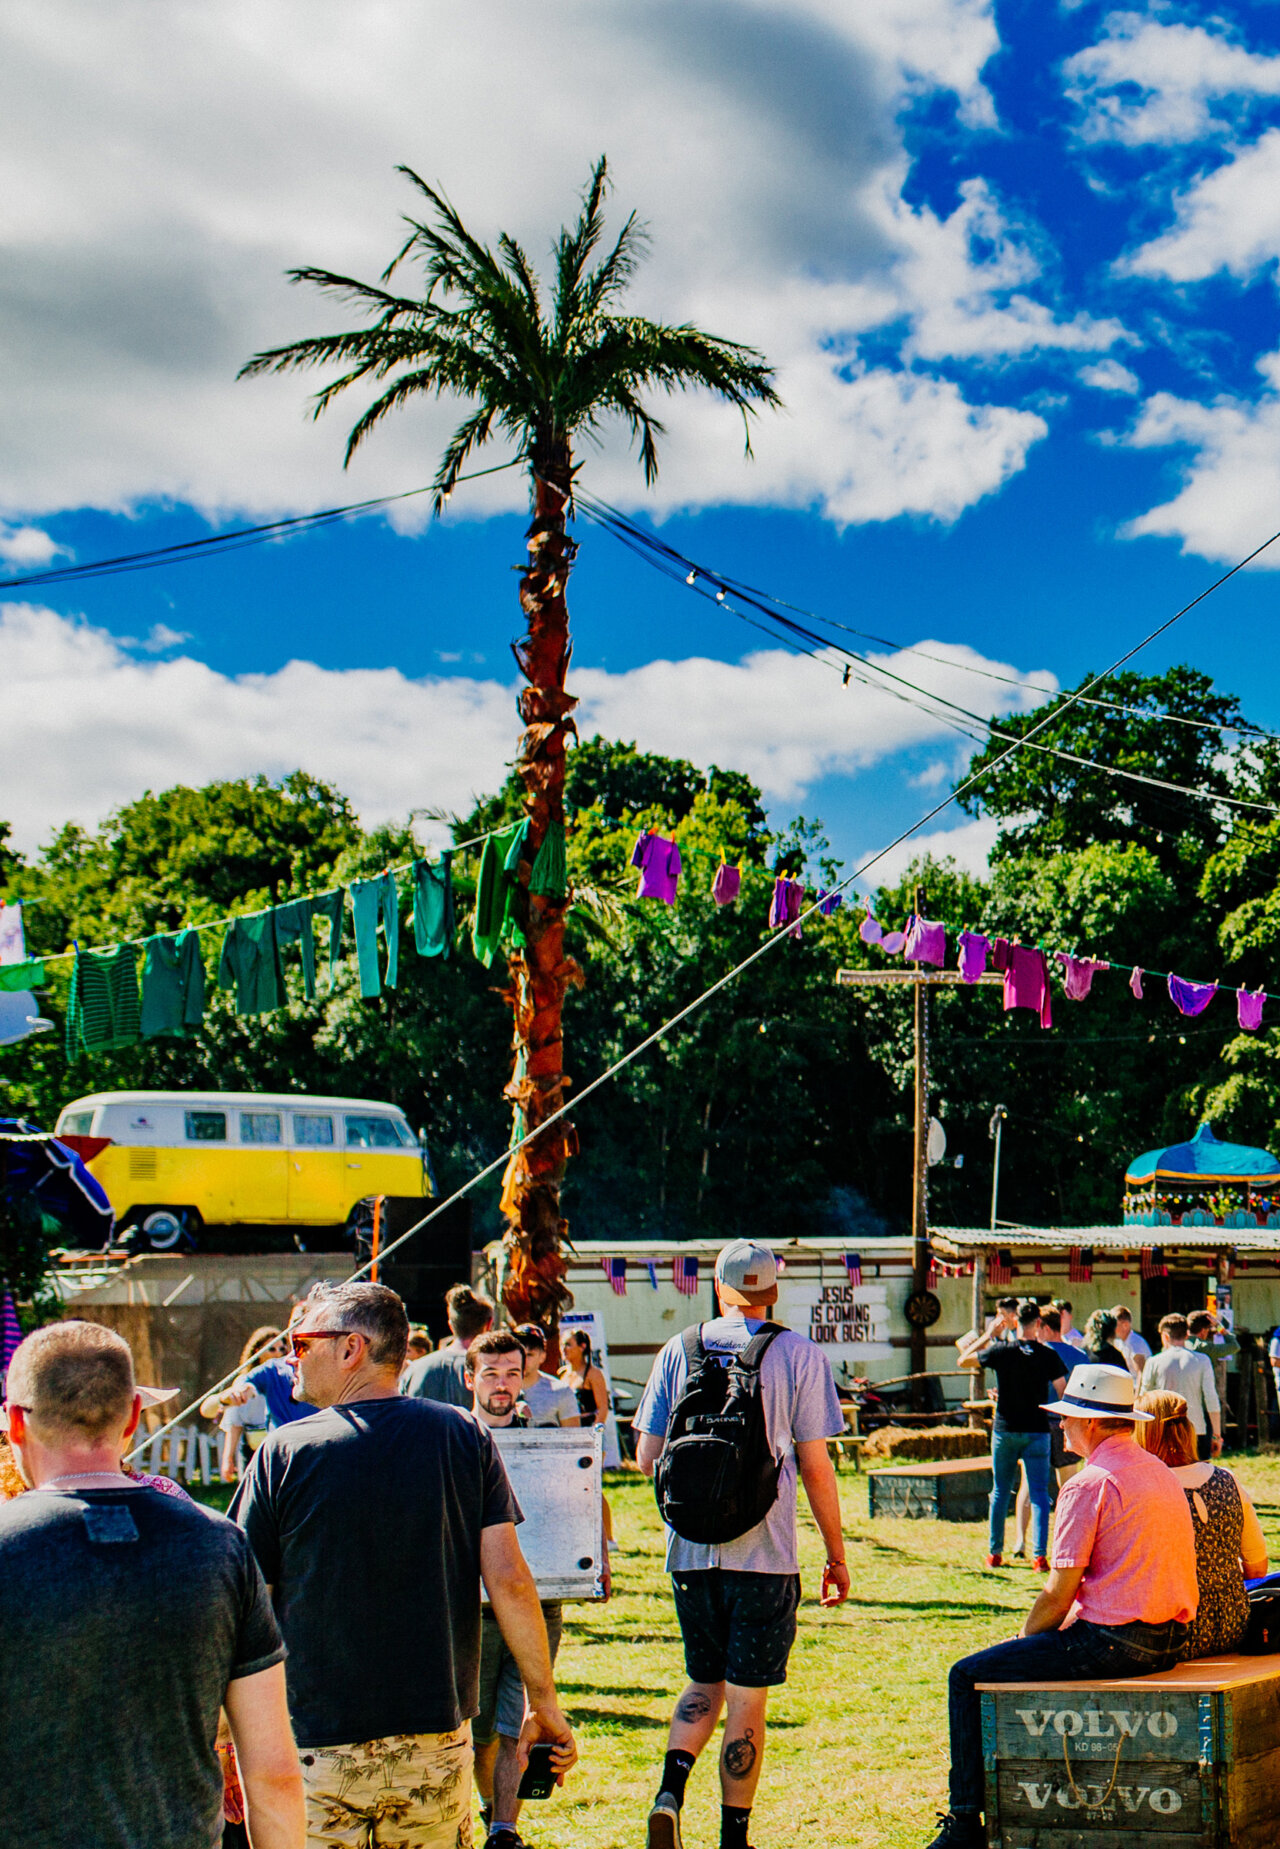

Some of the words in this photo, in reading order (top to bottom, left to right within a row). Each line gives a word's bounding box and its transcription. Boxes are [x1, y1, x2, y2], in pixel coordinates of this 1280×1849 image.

[818, 1286, 854, 1304] JESUS
[811, 1304, 822, 1323] IS
[826, 1304, 870, 1323] COMING
[809, 1324, 838, 1343] LOOK
[842, 1323, 876, 1342] BUSY!
[1015, 1709, 1179, 1738] VOLVO
[1074, 1742, 1089, 1752] KD
[1017, 1782, 1183, 1815] VOLVO
